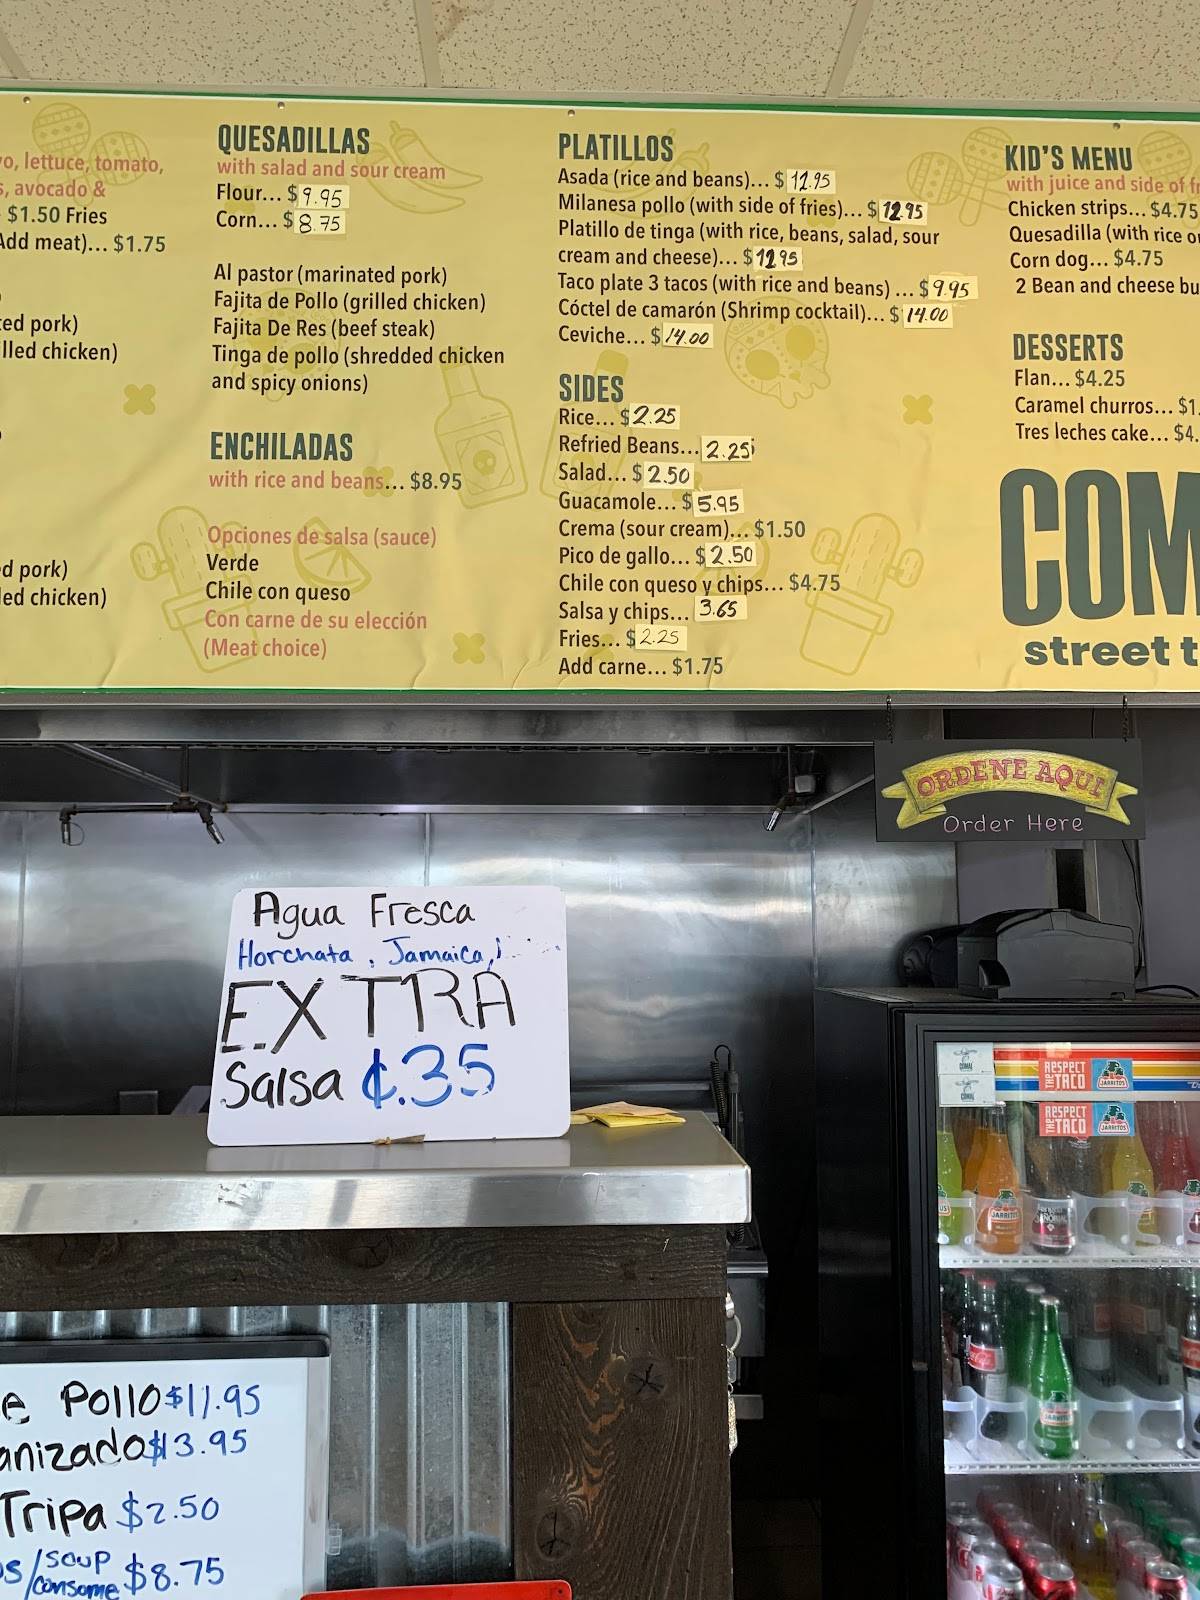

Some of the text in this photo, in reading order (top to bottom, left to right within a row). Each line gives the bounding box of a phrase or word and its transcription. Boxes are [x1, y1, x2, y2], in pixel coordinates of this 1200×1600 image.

[219, 124, 369, 155] QUESADILLAS
[559, 133, 673, 162] PLATILLOS
[25, 152, 163, 174] lettuce, tomato,
[217, 157, 445, 179] with salad and sour cream
[1072, 146, 1132, 171] MENU
[15, 179, 87, 197] avocado
[558, 168, 650, 188] Asada (rice
[1048, 174, 1164, 195] juice side
[8, 205, 106, 224] $1.50 Fries
[560, 194, 773, 217] Milanesa pollo (with side
[1009, 200, 1198, 219] Chicken $4.75
[114, 234, 165, 253] $1.75
[560, 219, 939, 245] Platillo tinga (with rice, beans, salad, sour
[1010, 224, 1101, 242] Quesadilla
[559, 250, 609, 263] cream
[1011, 248, 1163, 268] Corn $4.75
[214, 263, 446, 288] Al pastor (marinated pork)
[558, 273, 889, 300] Taco plate tacos rice beans)
[1033, 276, 1174, 293] Bean cheese
[215, 291, 485, 314] Fajita de Pollo (grilled chicken)
[559, 299, 790, 324] Cóctel camarón (Shrimp
[31, 314, 77, 337] pork)
[214, 317, 434, 340] Fajita De Res (beef steak)
[43, 341, 117, 364] chicken)
[212, 345, 504, 369] Tinga de pollo (shredded chicken
[1013, 334, 1123, 361] DESSERTS
[212, 372, 367, 395] and spicy onions)
[560, 374, 623, 403] SIDES
[1075, 369, 1124, 388] $4.25
[1016, 396, 1083, 413] Caramel
[1016, 422, 1106, 440] Tres leches
[211, 432, 352, 461] ENCHILADAS
[560, 434, 620, 453] Refried
[209, 470, 461, 491] with rice $8.95
[208, 526, 436, 549] Opciones salsa (sauce)
[559, 519, 805, 539] Crema (sour $1.50
[207, 553, 258, 571] Verde
[560, 547, 593, 563] Pico
[20, 560, 67, 583] pork)
[206, 581, 350, 605] Chile con queso
[560, 573, 840, 597] Chile queso $4.75
[31, 587, 106, 609] chicken)
[205, 609, 426, 629] Con carne su elección
[559, 601, 603, 619] Salsa
[204, 638, 326, 660] (Meat choice)
[1024, 636, 1170, 666] street
[559, 656, 723, 679] Add $1.75
[917, 759, 1027, 797] ORDENE
[943, 814, 1084, 833] Order Here
[254, 891, 476, 939] Agua Fresca
[220, 969, 517, 1055] EXTRA
[221, 1061, 343, 1109] Salsa
[1055, 1073, 1085, 1089] TACO
[1056, 1118, 1086, 1134] TACO
[60, 1380, 161, 1418] Pollo
[0, 1489, 220, 1538] Tripa $2.50
